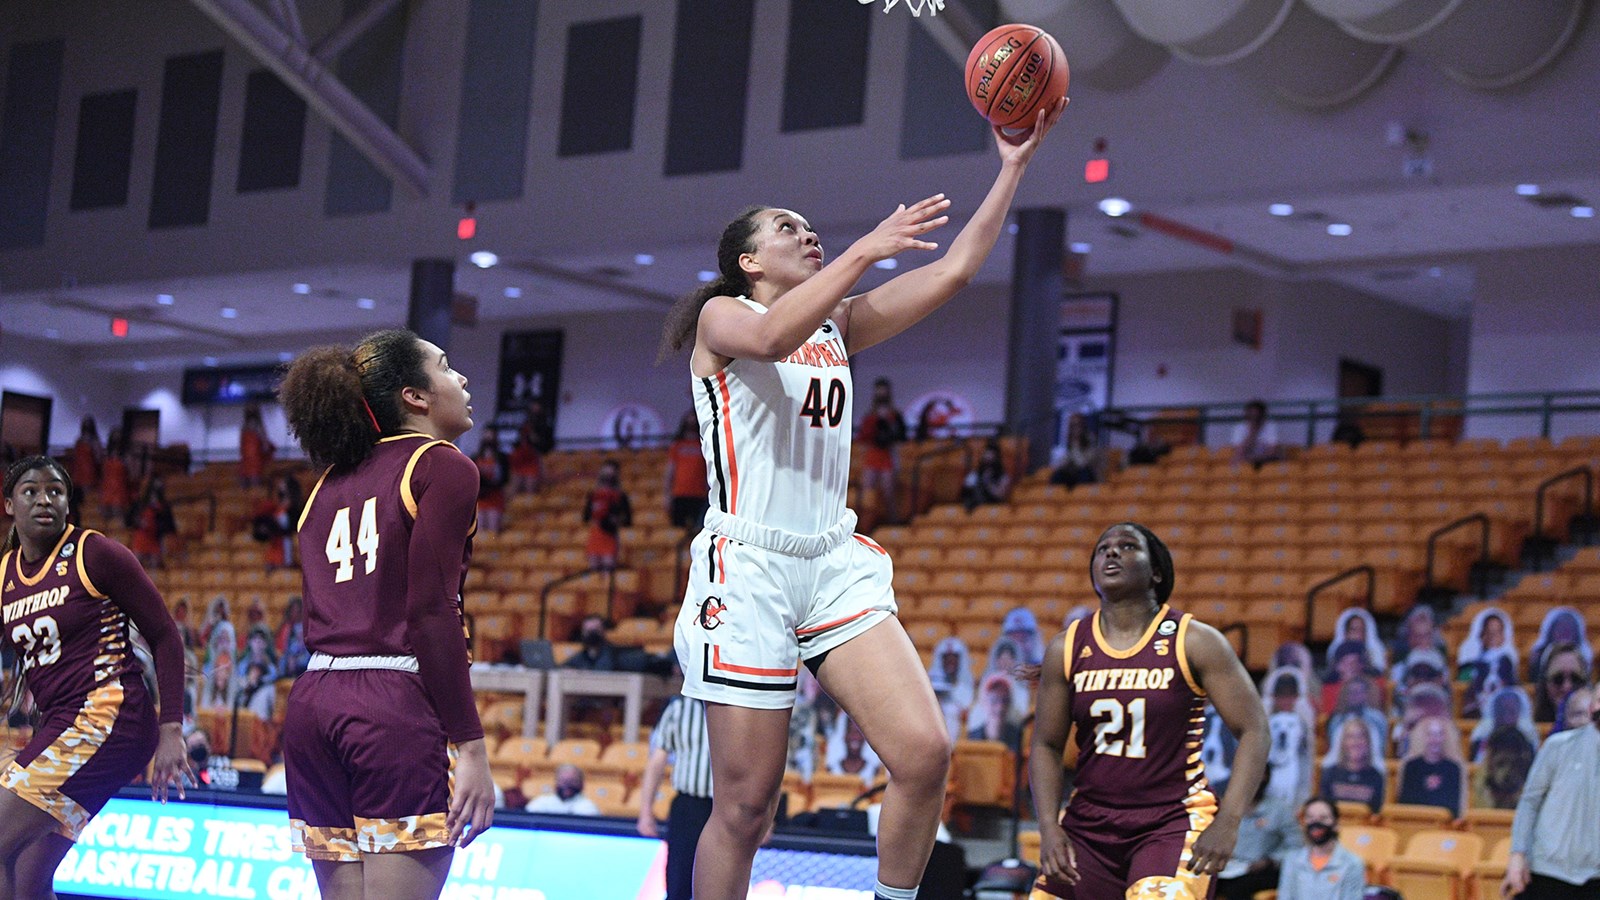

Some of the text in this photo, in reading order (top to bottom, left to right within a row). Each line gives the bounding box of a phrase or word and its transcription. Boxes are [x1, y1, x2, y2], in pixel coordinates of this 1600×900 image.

[976, 36, 1023, 103] SPALDING
[800, 377, 846, 428] 40
[325, 496, 379, 584] 44
[2, 585, 70, 625] WINTHROP
[11, 615, 62, 670] 23
[1073, 667, 1175, 693] WINTHROP
[1089, 697, 1147, 759] 21
[77, 812, 195, 853] RCULES
[203, 819, 293, 862] TIRES
[53, 847, 256, 899] BASKETBALL
